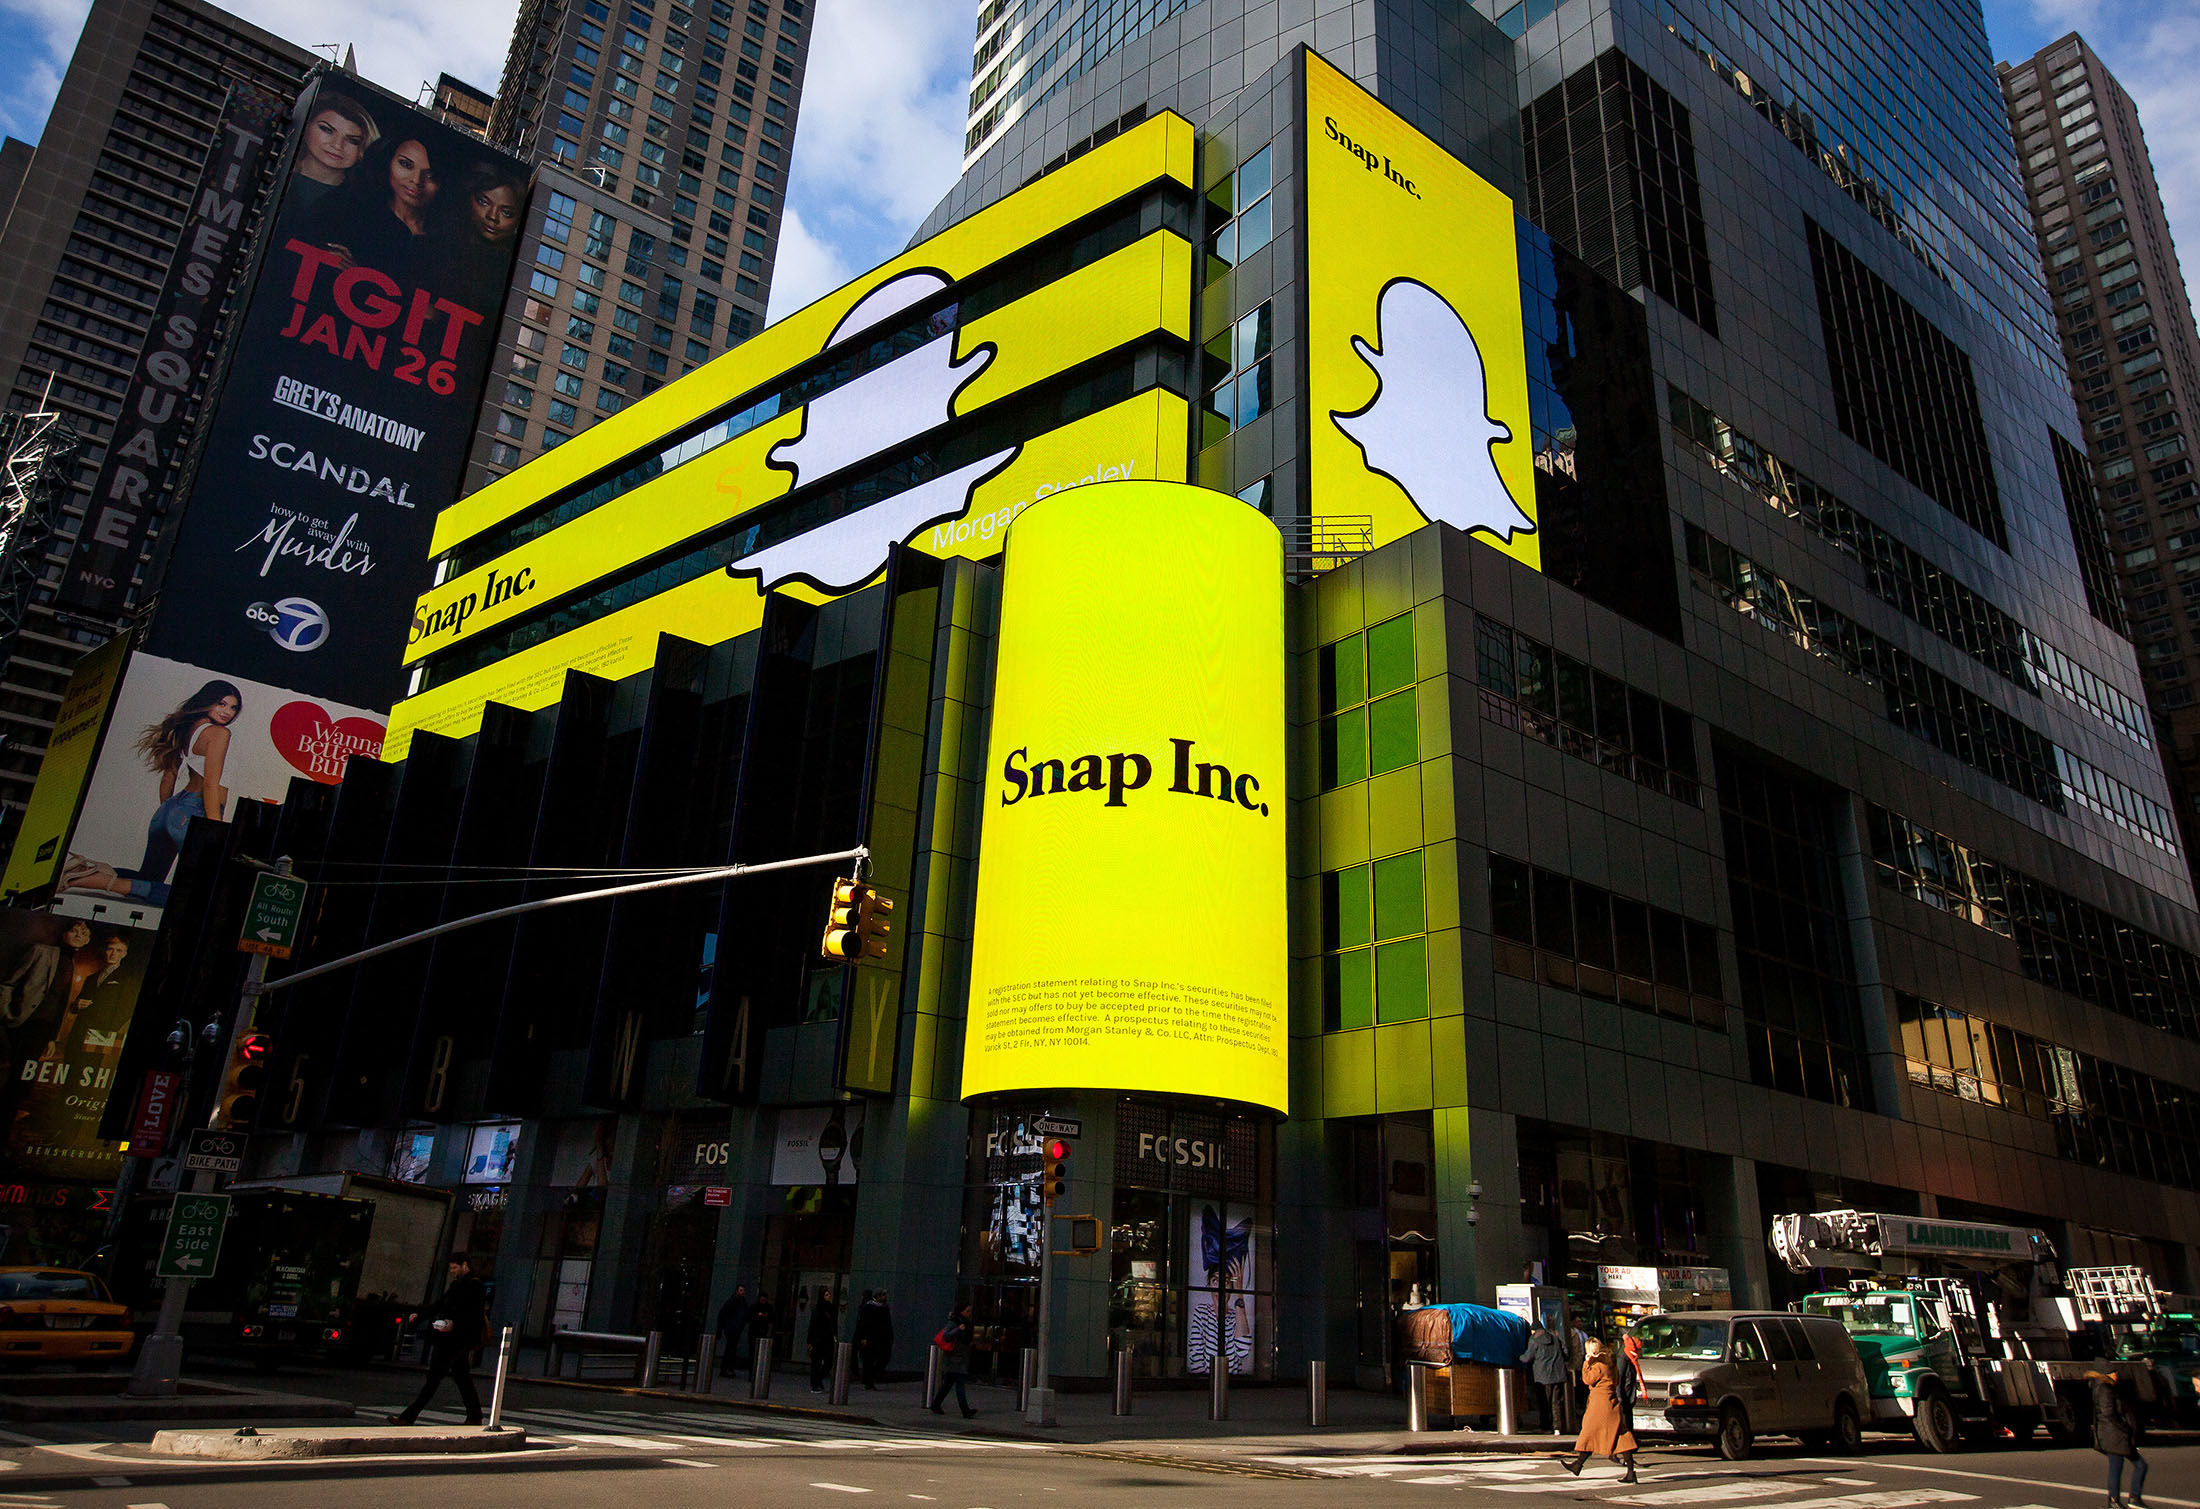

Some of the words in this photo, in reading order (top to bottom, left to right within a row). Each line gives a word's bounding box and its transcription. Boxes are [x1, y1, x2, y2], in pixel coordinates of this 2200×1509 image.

[1325, 116, 1379, 172] Snap
[1383, 156, 1422, 200] Inc.
[182, 122, 264, 296] TIMES
[285, 238, 484, 360] TGIT
[280, 304, 387, 371] JAN
[394, 347, 457, 396] 26
[274, 375, 342, 420] GREY'S
[338, 404, 426, 452] ANATOMY
[93, 315, 198, 550] SQUARE
[248, 434, 415, 508] SCANDAL
[270, 502, 294, 518] how
[298, 512, 310, 524] to
[310, 517, 328, 530] get
[234, 512, 376, 577] Murder
[308, 527, 337, 544] away
[346, 538, 370, 553] with
[80, 570, 116, 590] NYC
[408, 594, 476, 645] Snap
[480, 566, 536, 613] Inc.
[246, 607, 280, 625] abc
[273, 599, 327, 648] 7
[314, 720, 382, 755] Wanna
[1002, 746, 1152, 808] Snap
[1168, 738, 1269, 817] Inc.
[257, 912, 288, 927] South
[993, 982, 1032, 996] registration
[1033, 979, 1078, 988] statement
[1080, 978, 1118, 988] relating
[1120, 978, 1130, 987] to
[1134, 979, 1158, 990] Snap
[1187, 984, 1228, 998] securities
[1230, 990, 1244, 1000] has
[1012, 993, 1026, 1002] SEC
[1028, 992, 1042, 1000] but
[1062, 990, 1076, 998] not
[1080, 990, 1094, 1000] yet
[1096, 990, 1134, 998] become
[1138, 990, 1181, 1002] effective.
[1184, 995, 1209, 1006] These
[1211, 1000, 1248, 1012] securities
[1250, 1008, 1262, 1019] may
[1012, 1006, 1026, 1015] may
[1028, 1002, 1053, 1012] offers
[1066, 1002, 1084, 1012] buy
[1086, 1002, 1098, 1010] be
[1100, 1003, 1144, 1012] accepted
[1148, 1004, 1170, 1014] prior
[1186, 1008, 1200, 1016] the
[1202, 1010, 1222, 1019] time
[1224, 1013, 1236, 1022] the
[986, 1018, 1016, 1030] statement
[1019, 1016, 1055, 1024] becomes
[1114, 1016, 1168, 1025] prospectus
[1172, 1019, 1208, 1032] relating
[1210, 1022, 1218, 1030] to
[1220, 1024, 1240, 1034] these
[1242, 1029, 1270, 1042] securities
[1007, 1027, 1040, 1037] obtained
[1042, 1026, 1064, 1034] from
[1066, 1026, 1102, 1036] Morgan
[1105, 1026, 1142, 1038] Stanley
[1144, 1028, 1154, 1036] &
[1156, 1028, 1171, 1038] Co.
[1174, 1030, 1192, 1040] LLC,
[1216, 1035, 1256, 1050] Prospectus
[1014, 1040, 1018, 1048] 2
[1034, 1038, 1048, 1047] NY,
[1049, 1038, 1062, 1046] NY
[21, 1059, 70, 1085] BEN
[144, 1074, 171, 1128] LOVE
[1040, 1122, 1056, 1131] ONE
[1059, 1124, 1074, 1133] WAY
[189, 1156, 210, 1168] BIKE
[214, 1158, 239, 1170] PATH
[178, 1224, 214, 1236] East
[1906, 1223, 2012, 1250] LANDMARK
[176, 1238, 210, 1250] Side
[1600, 1266, 1619, 1274] YOUR
[1660, 1270, 1680, 1280] YOUR
[1682, 1270, 1692, 1280] AD
